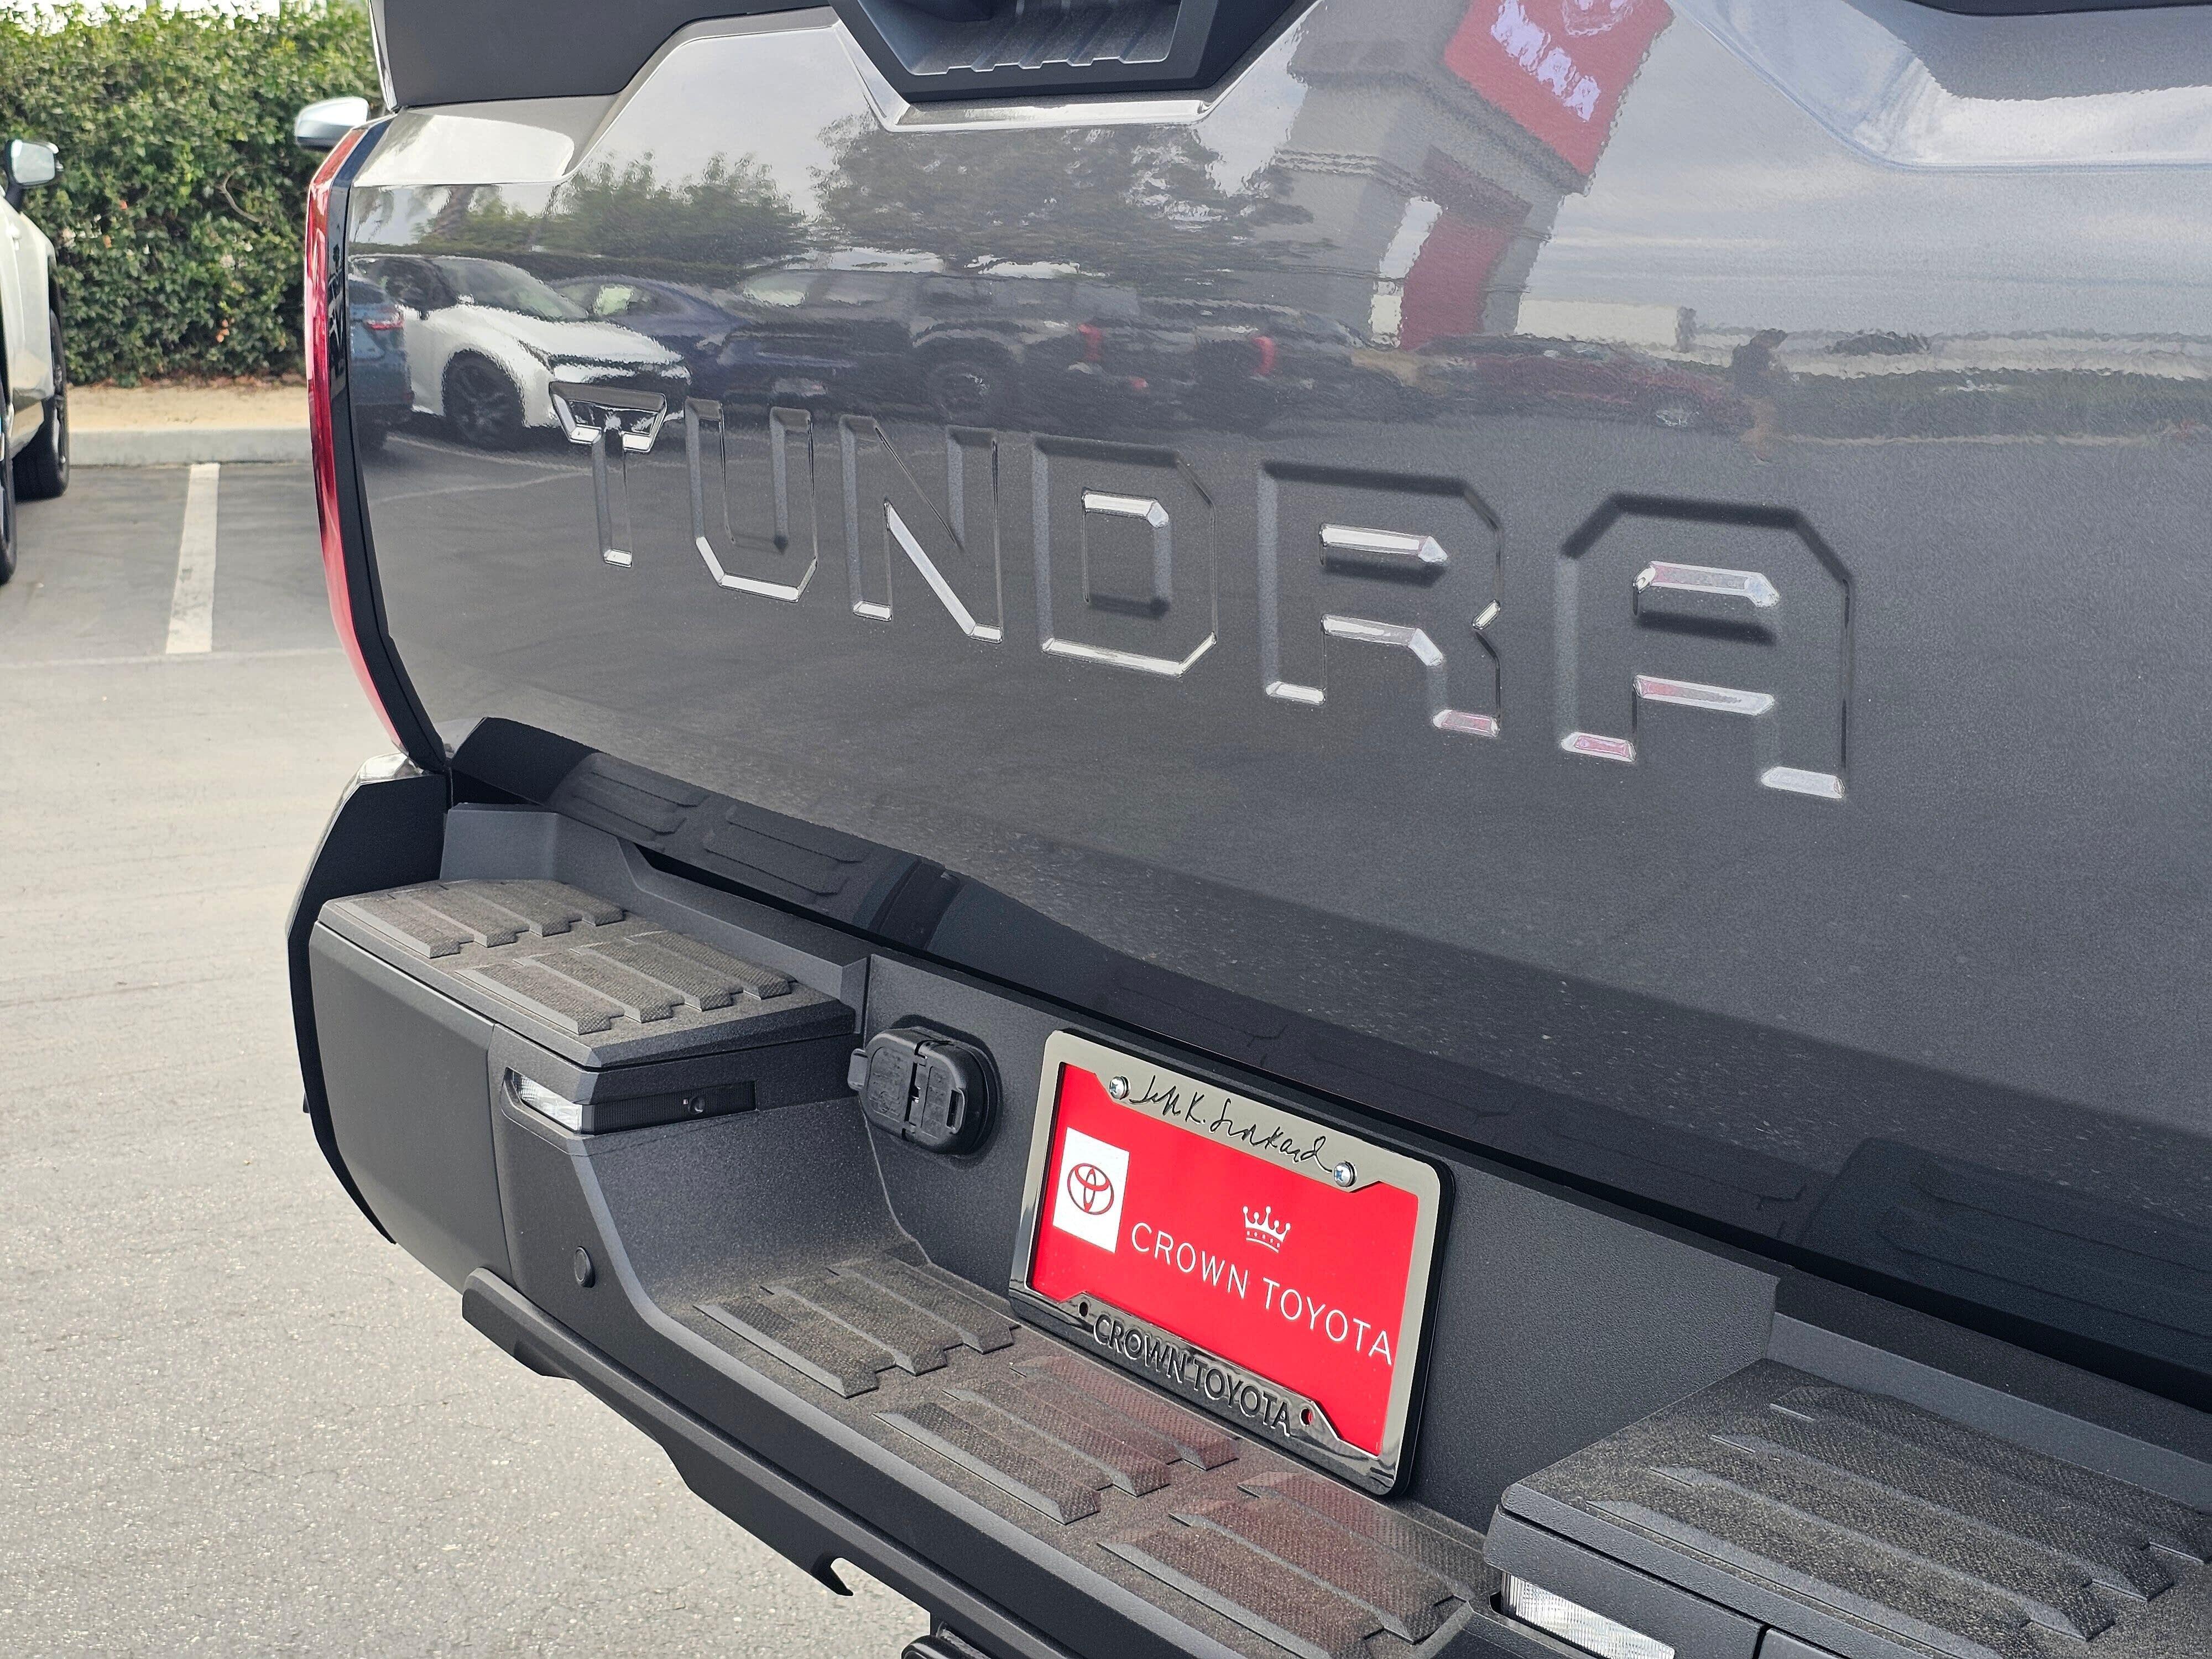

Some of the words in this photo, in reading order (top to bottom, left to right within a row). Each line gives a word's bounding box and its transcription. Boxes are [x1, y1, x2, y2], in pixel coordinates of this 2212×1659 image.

[549, 382, 1852, 800] TUNDRA
[1185, 1091, 1207, 1124] K.
[1131, 1222, 1248, 1300] CROWN
[1263, 1278, 1392, 1366] TOYOTA
[1093, 1314, 1187, 1383] CROWN
[1192, 1357, 1291, 1437] TOYOTA
